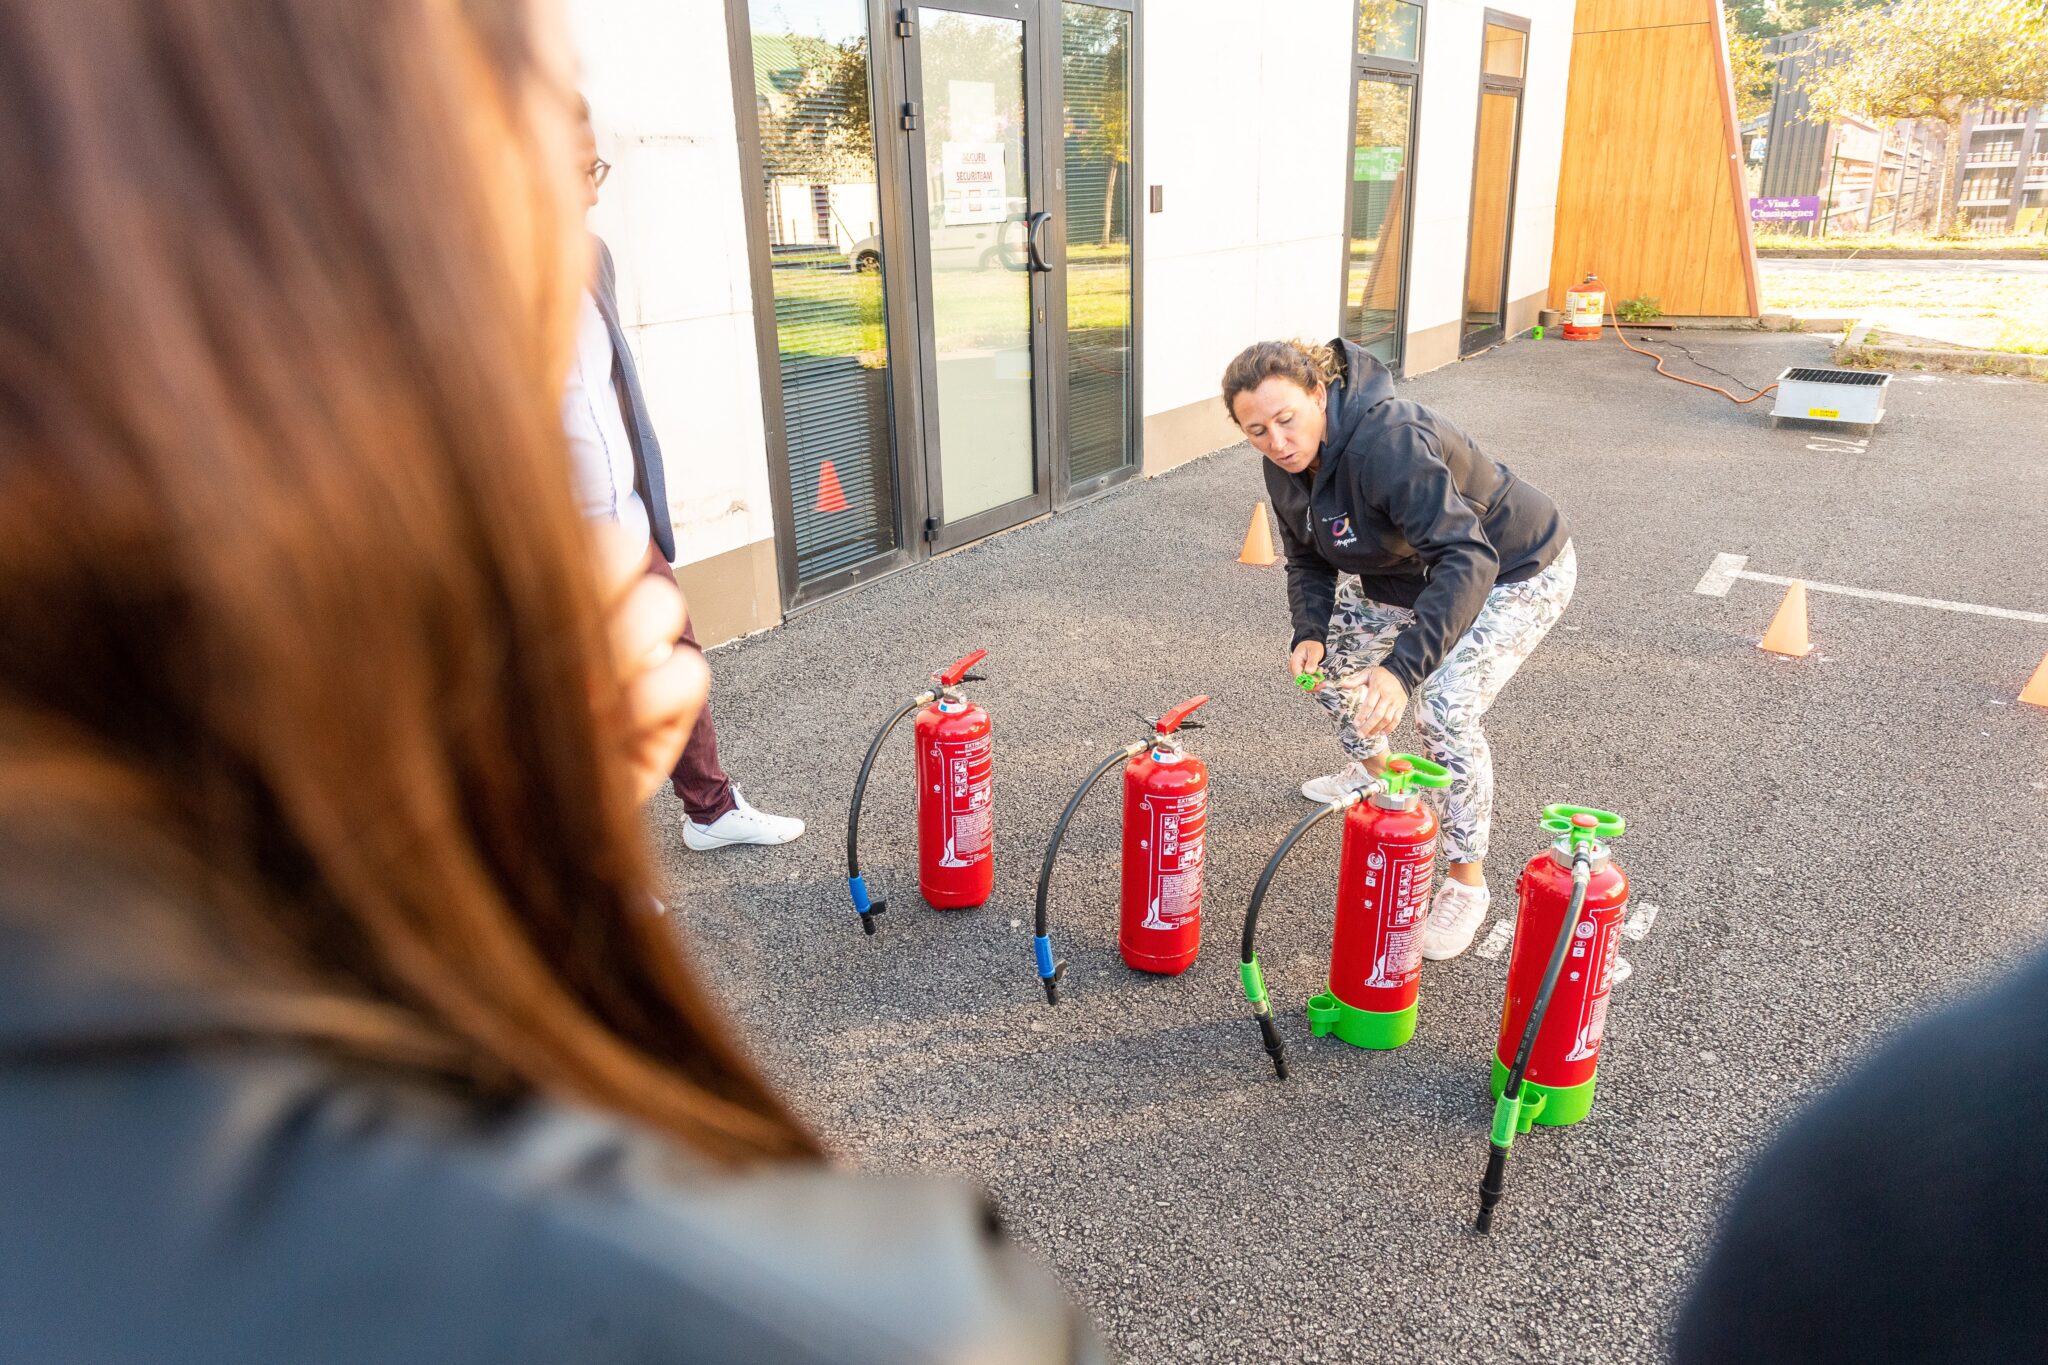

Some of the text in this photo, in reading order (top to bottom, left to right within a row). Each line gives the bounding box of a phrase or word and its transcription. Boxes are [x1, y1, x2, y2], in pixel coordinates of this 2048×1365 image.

[1767, 198, 1801, 208] Vins &
[1751, 209, 1814, 219] Champagnes
